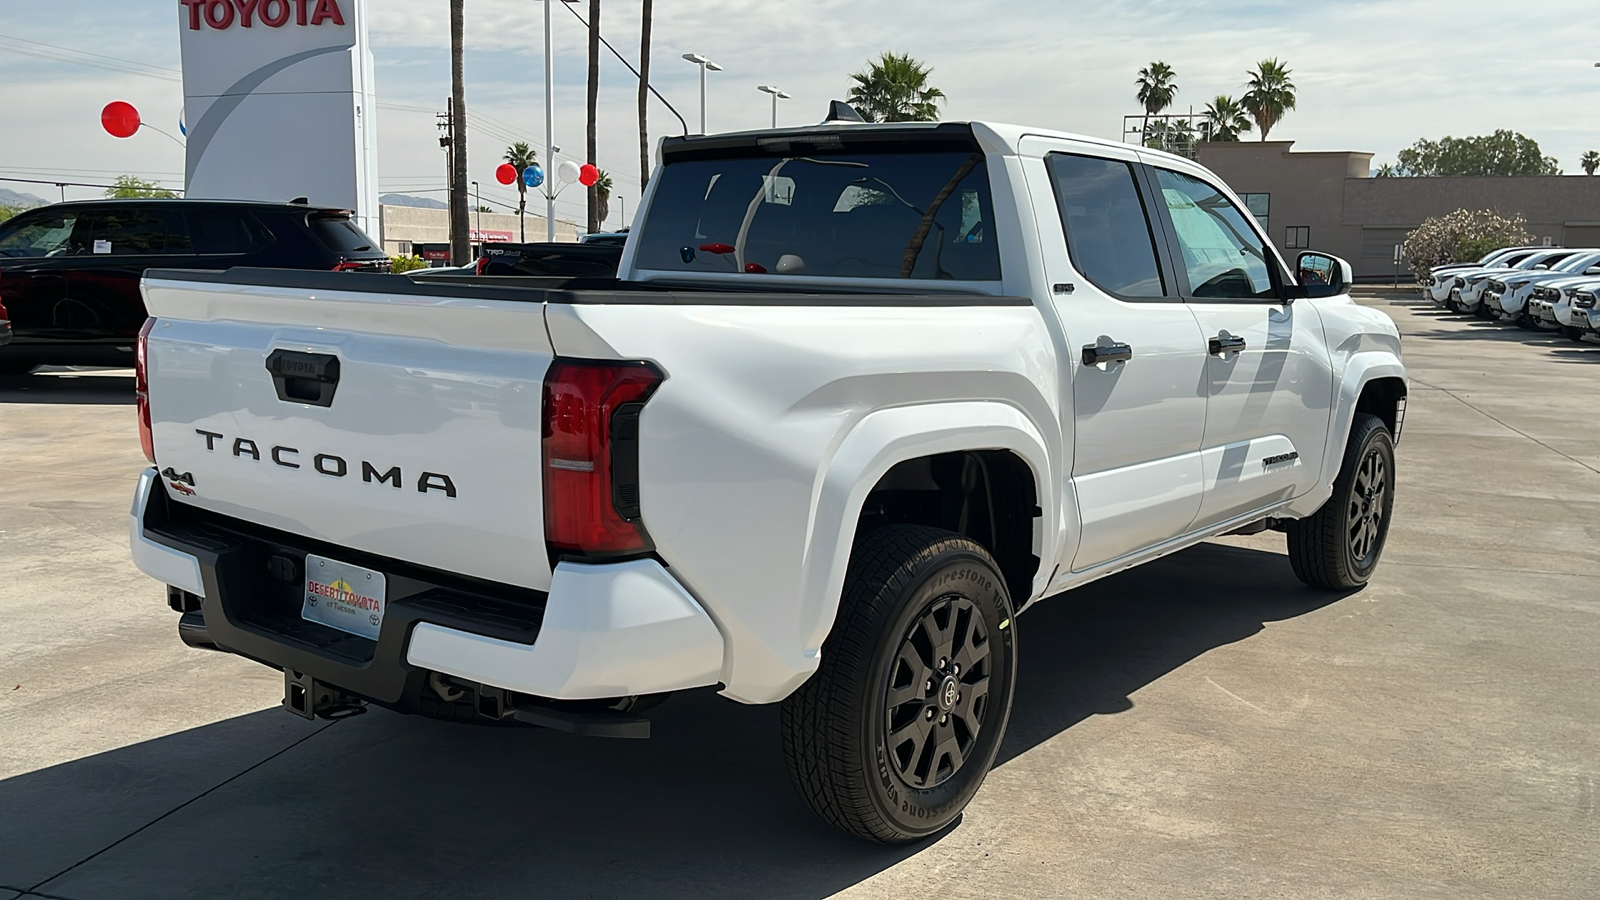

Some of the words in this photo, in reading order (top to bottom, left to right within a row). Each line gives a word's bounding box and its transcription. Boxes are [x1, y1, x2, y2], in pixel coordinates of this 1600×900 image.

[181, 0, 345, 30] TOYOTA
[485, 248, 504, 256] TRD
[282, 360, 316, 374] TOYOTA
[195, 428, 457, 498] TACOMA
[308, 580, 341, 600] DESERT
[343, 590, 380, 613] TOYOTA
[334, 602, 356, 616] Tucson
